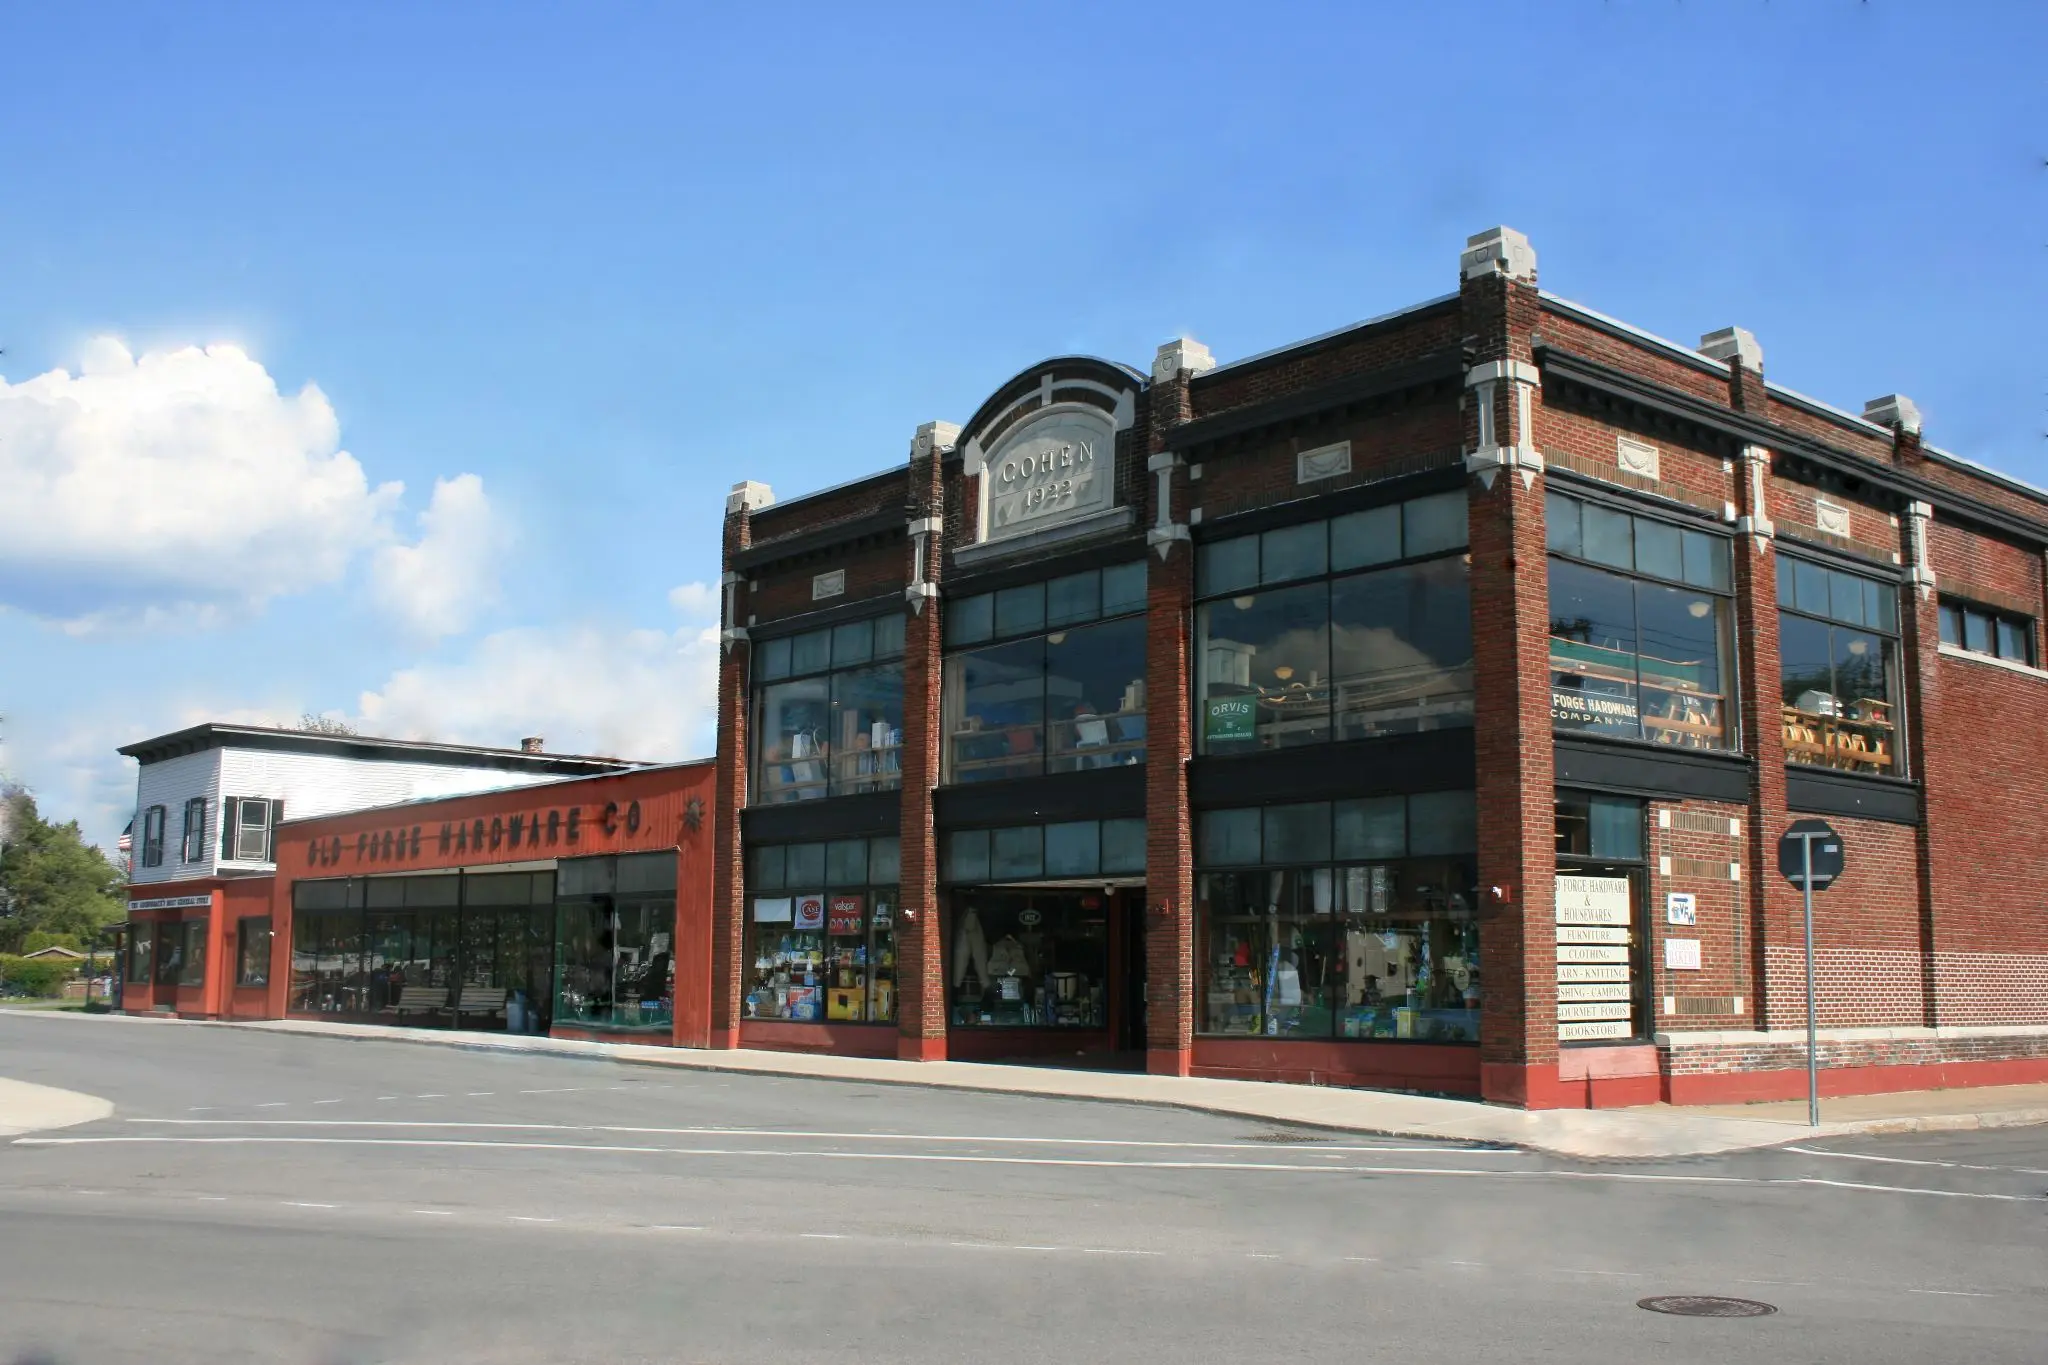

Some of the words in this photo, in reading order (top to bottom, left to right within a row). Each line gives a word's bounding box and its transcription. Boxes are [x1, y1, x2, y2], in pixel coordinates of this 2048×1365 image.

[1003, 441, 1093, 483] COHEN
[1027, 480, 1072, 506] 1922
[1211, 702, 1250, 716] ORVIS
[1552, 693, 1586, 711] FORGE
[1588, 698, 1638, 718] HARDWARE
[1550, 709, 1623, 726] COMPANY
[307, 836, 342, 868] OLD
[357, 826, 422, 864] FORGE
[438, 807, 582, 857] HARDWARE
[1563, 879, 1587, 893] FORGE
[1589, 880, 1628, 894] HARDWARE
[834, 900, 857, 912] valspar
[1584, 896, 1591, 907] &
[1564, 907, 1612, 922] HOUSEWARES
[1680, 903, 1695, 924] VFW
[1567, 929, 1611, 940] FURNITURE
[1568, 948, 1610, 959] CLOTHING
[1560, 968, 1578, 979] ARN
[1585, 968, 1625, 979] KNITTING
[1558, 987, 1585, 998] SHING
[1591, 987, 1627, 997] CAMPING
[1600, 1006, 1627, 1016] FOODS
[1565, 1025, 1618, 1037] BOOKSTORE
